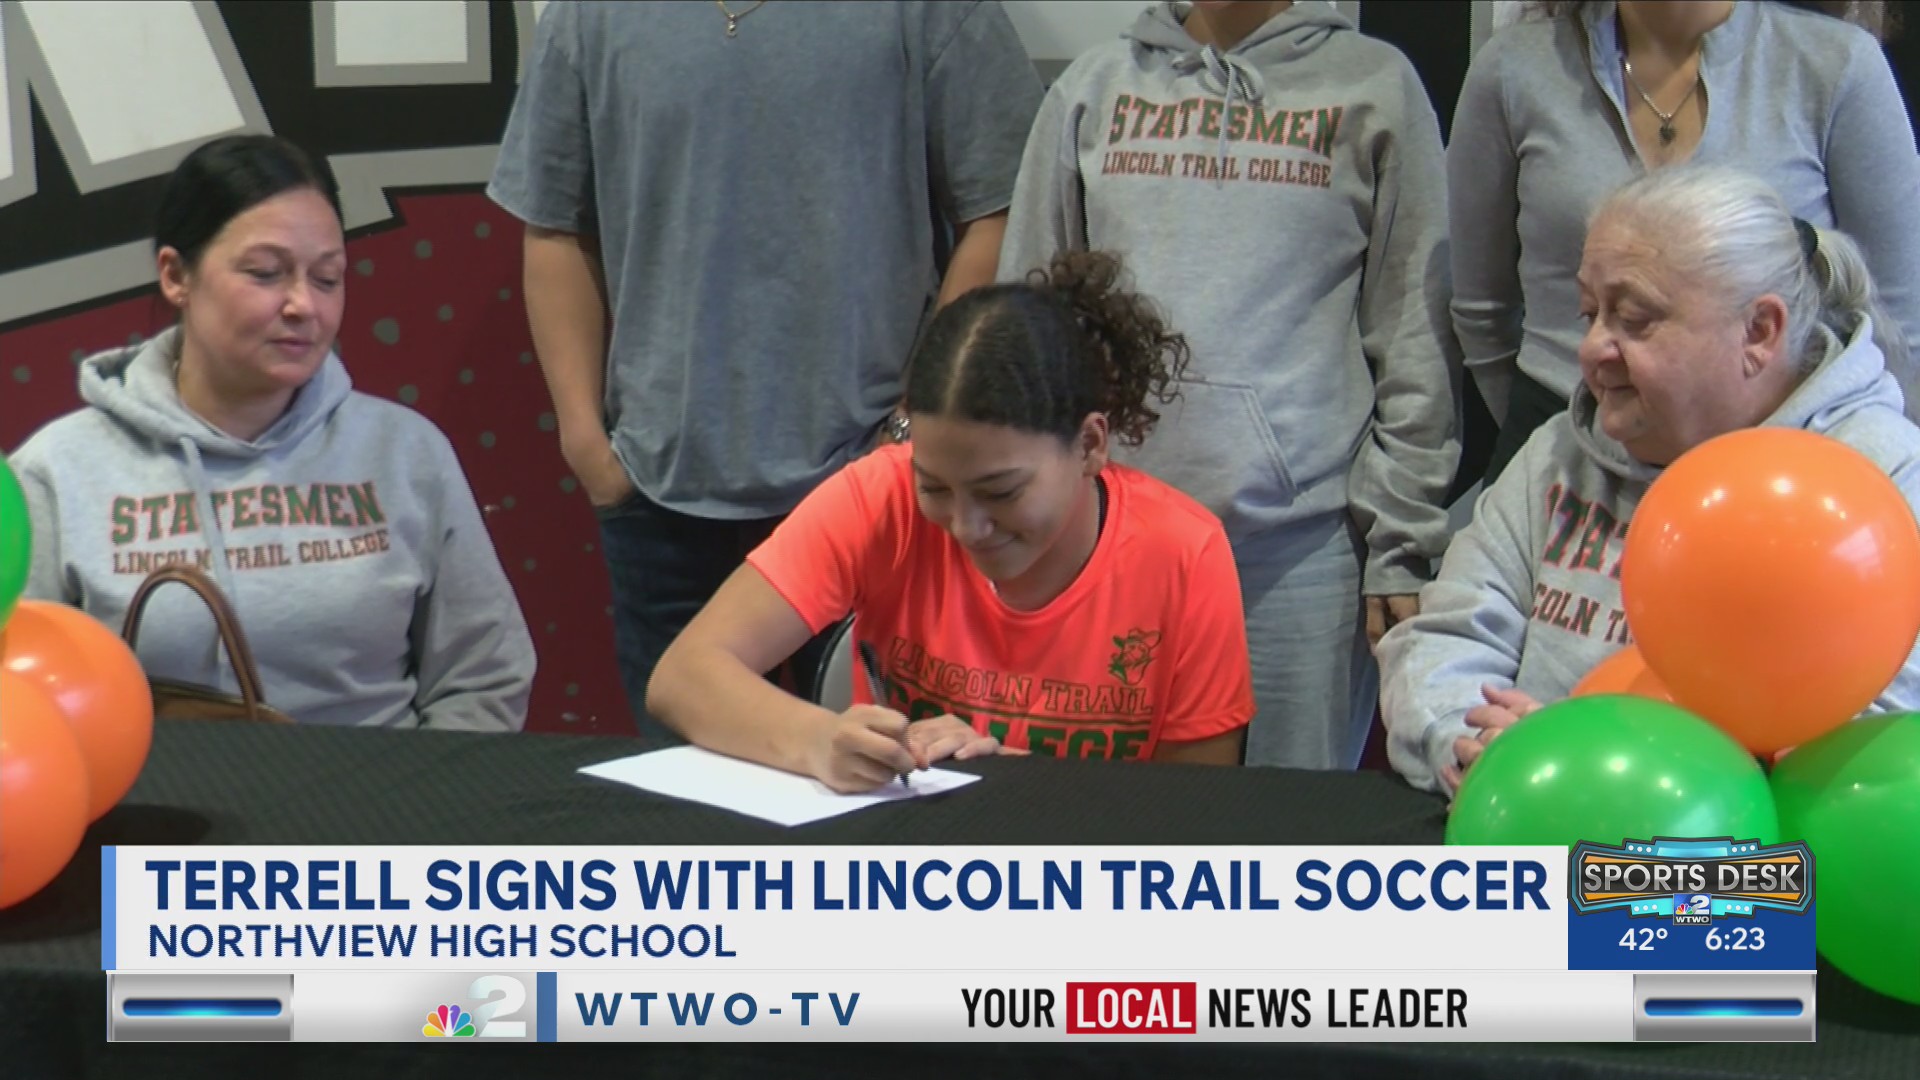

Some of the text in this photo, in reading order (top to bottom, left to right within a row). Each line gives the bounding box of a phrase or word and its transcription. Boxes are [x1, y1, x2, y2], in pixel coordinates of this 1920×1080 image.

[1108, 94, 1343, 158] STATESMEN
[1101, 151, 1332, 189] LINCOLN TRAIL COLLEGE
[111, 480, 387, 546] STATESMEN
[297, 528, 390, 564] COLLEGE
[889, 636, 1153, 716] LINCOLN TRAIL
